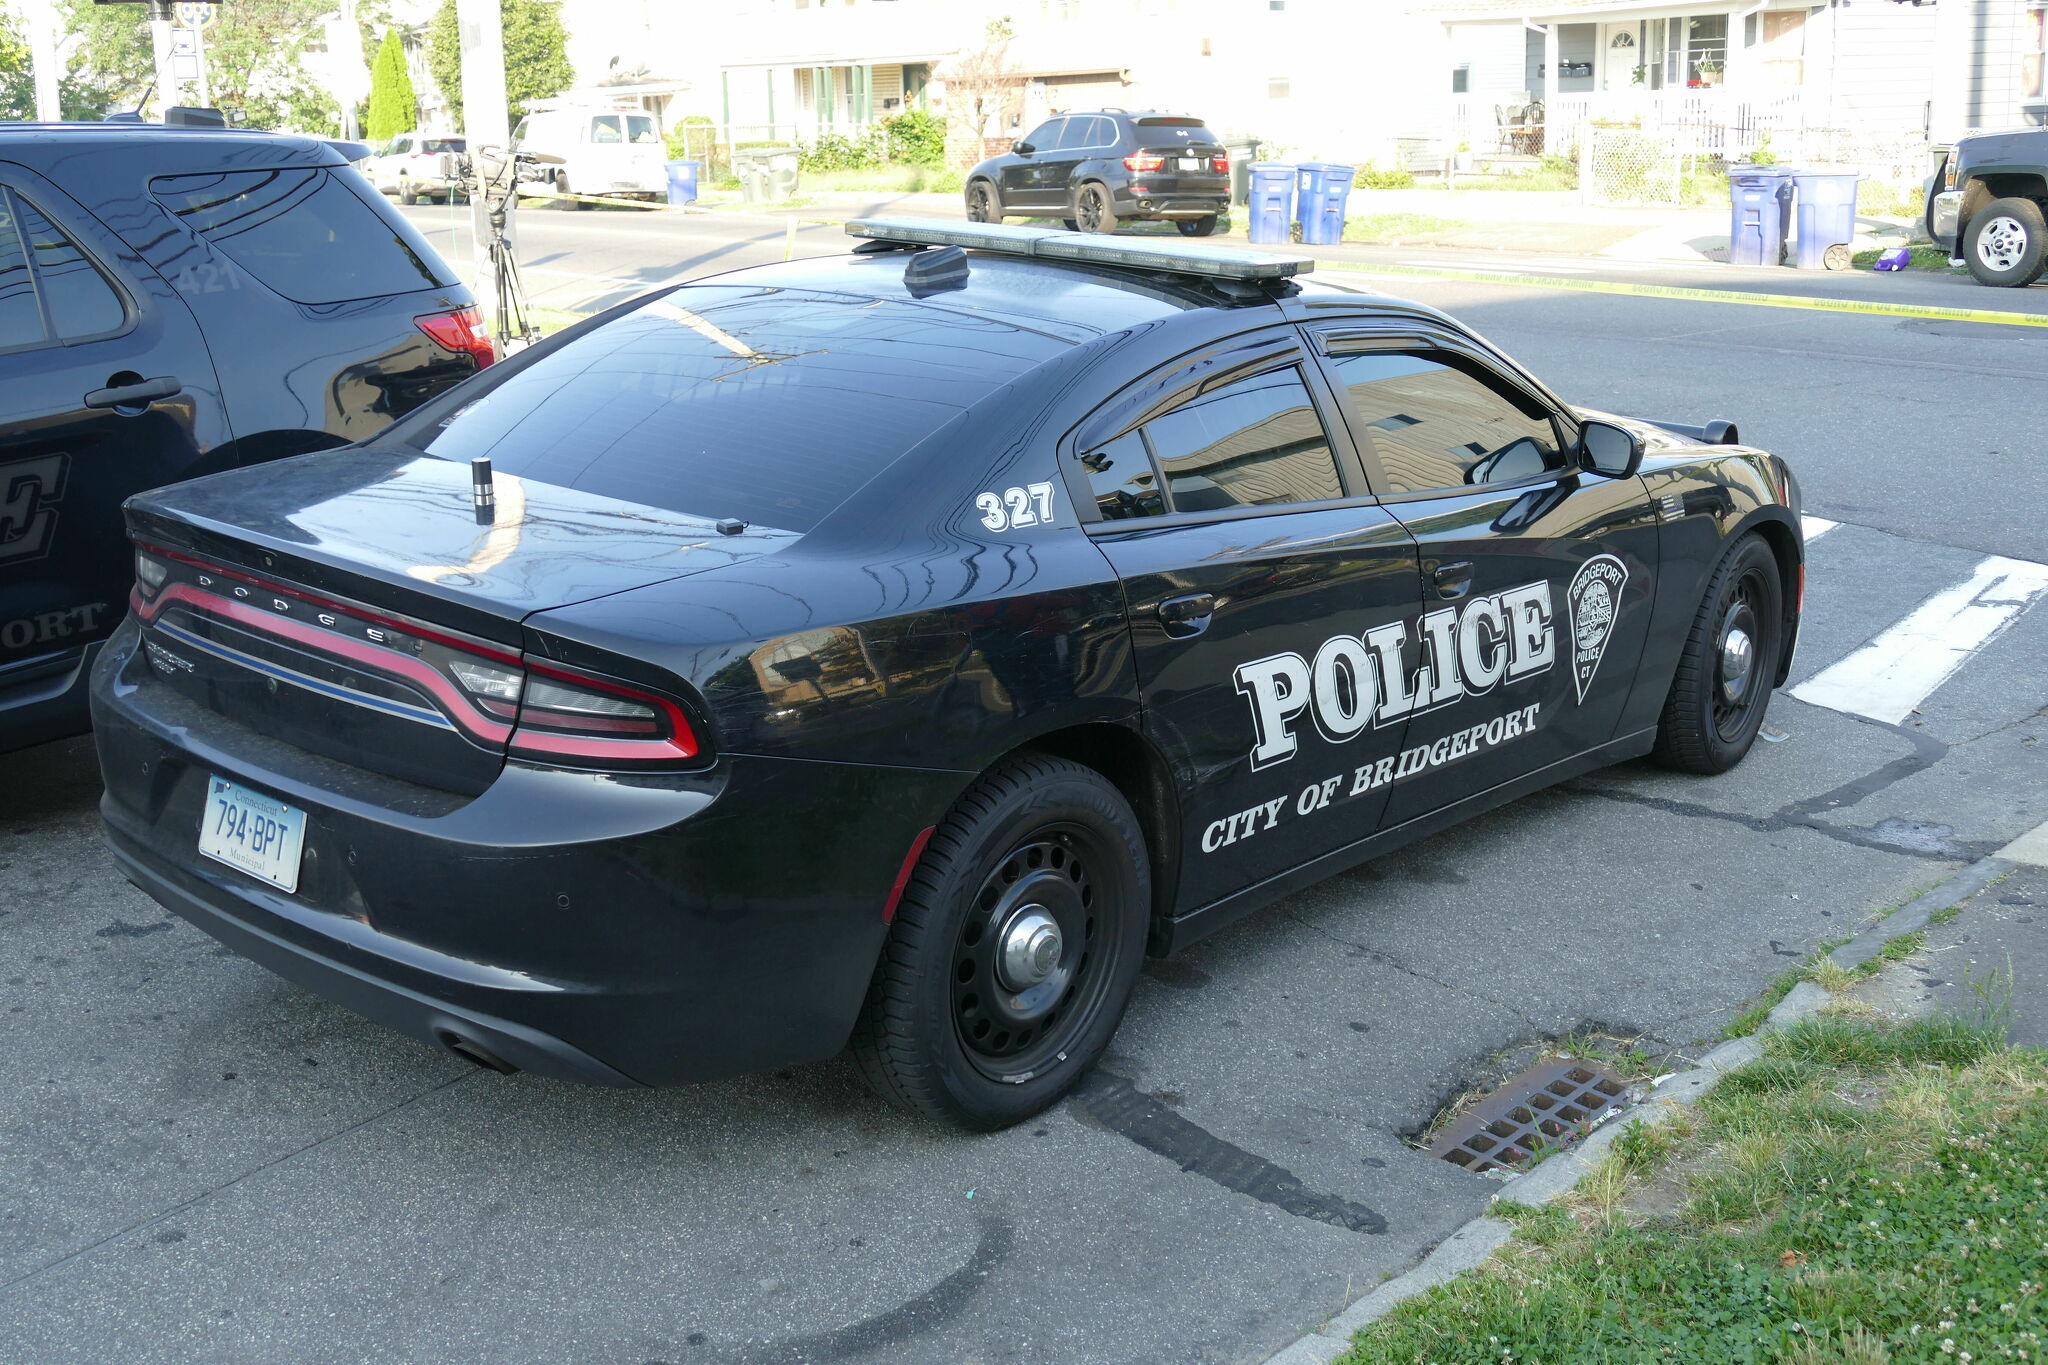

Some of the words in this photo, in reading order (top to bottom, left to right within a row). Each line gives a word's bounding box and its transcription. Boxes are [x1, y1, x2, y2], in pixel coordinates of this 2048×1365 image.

[178, 262, 241, 295] 421
[976, 481, 1055, 532] 327
[1572, 563, 1622, 601] BRIDGEPORT
[1, 602, 107, 649] ORT
[199, 575, 384, 642] DODGE
[1576, 647, 1600, 664] POLICE
[1581, 665, 1591, 679] CT
[1233, 579, 1555, 773] POLICE
[1201, 795, 1289, 854] CITY
[1297, 775, 1342, 816] OF
[1350, 703, 1541, 797] BRIDGEPORT
[235, 790, 278, 817] Connecticut
[229, 847, 266, 871] Municipal
